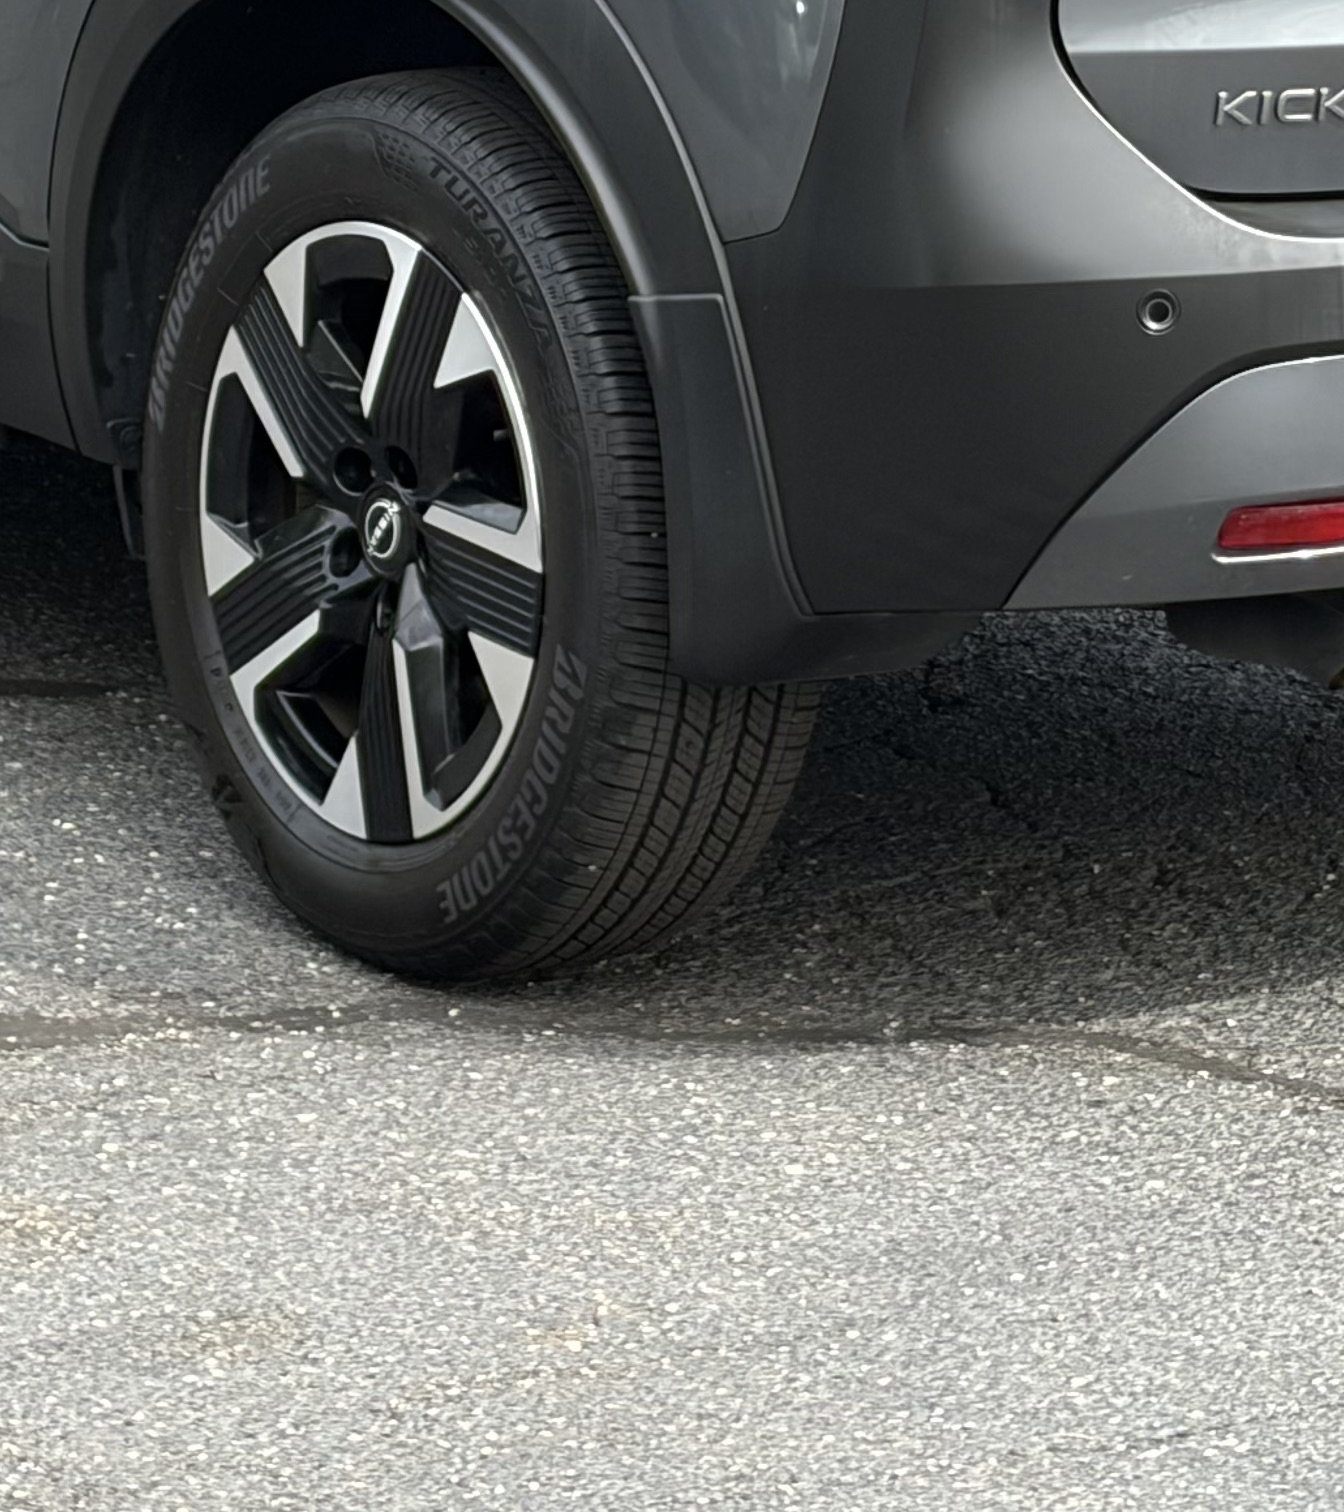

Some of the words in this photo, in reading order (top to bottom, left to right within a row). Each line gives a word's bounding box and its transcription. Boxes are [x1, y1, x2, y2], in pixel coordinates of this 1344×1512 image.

[148, 154, 271, 431] BRIDGESTONE
[428, 156, 554, 352] TURANZA
[436, 643, 588, 924] BRIDGESTONE
